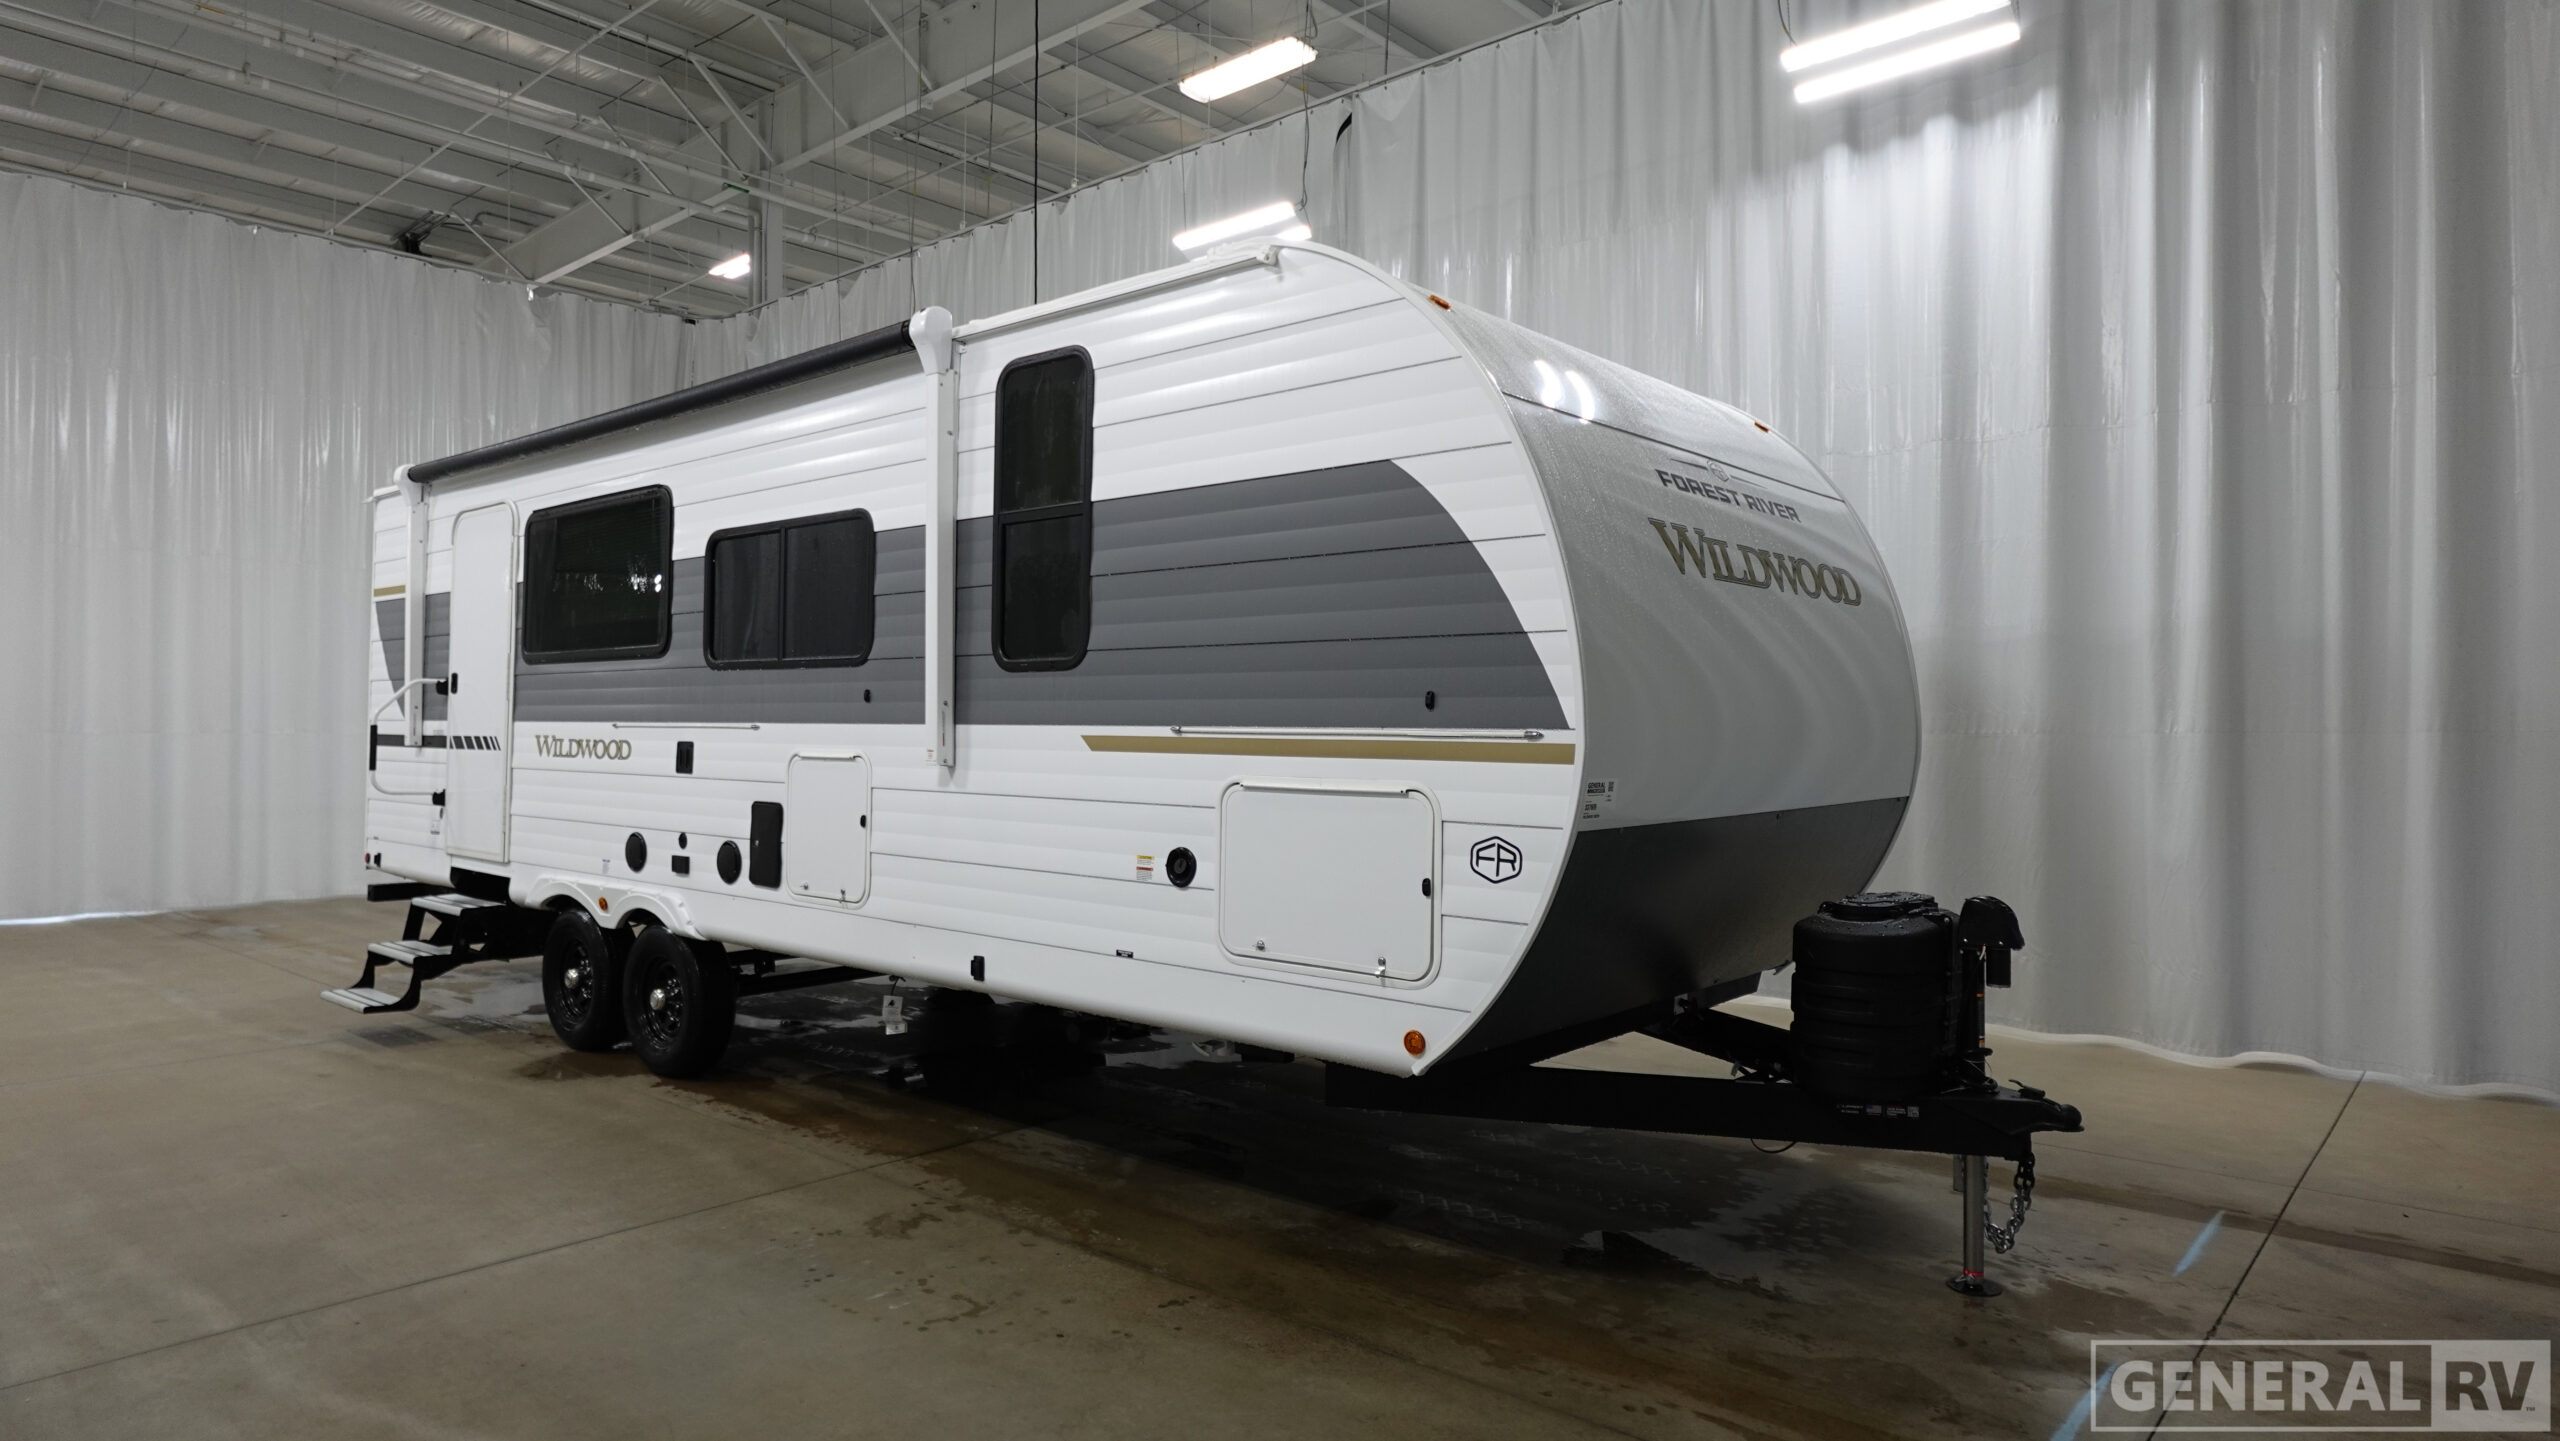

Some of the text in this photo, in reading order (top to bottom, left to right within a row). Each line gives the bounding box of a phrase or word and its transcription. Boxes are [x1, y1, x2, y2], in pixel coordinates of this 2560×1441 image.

[1655, 468, 1802, 523] FOREST RIVER
[1648, 517, 1862, 607] WILDWOOD
[535, 734, 633, 760] WILDWOOD
[1475, 842, 1517, 877] FR
